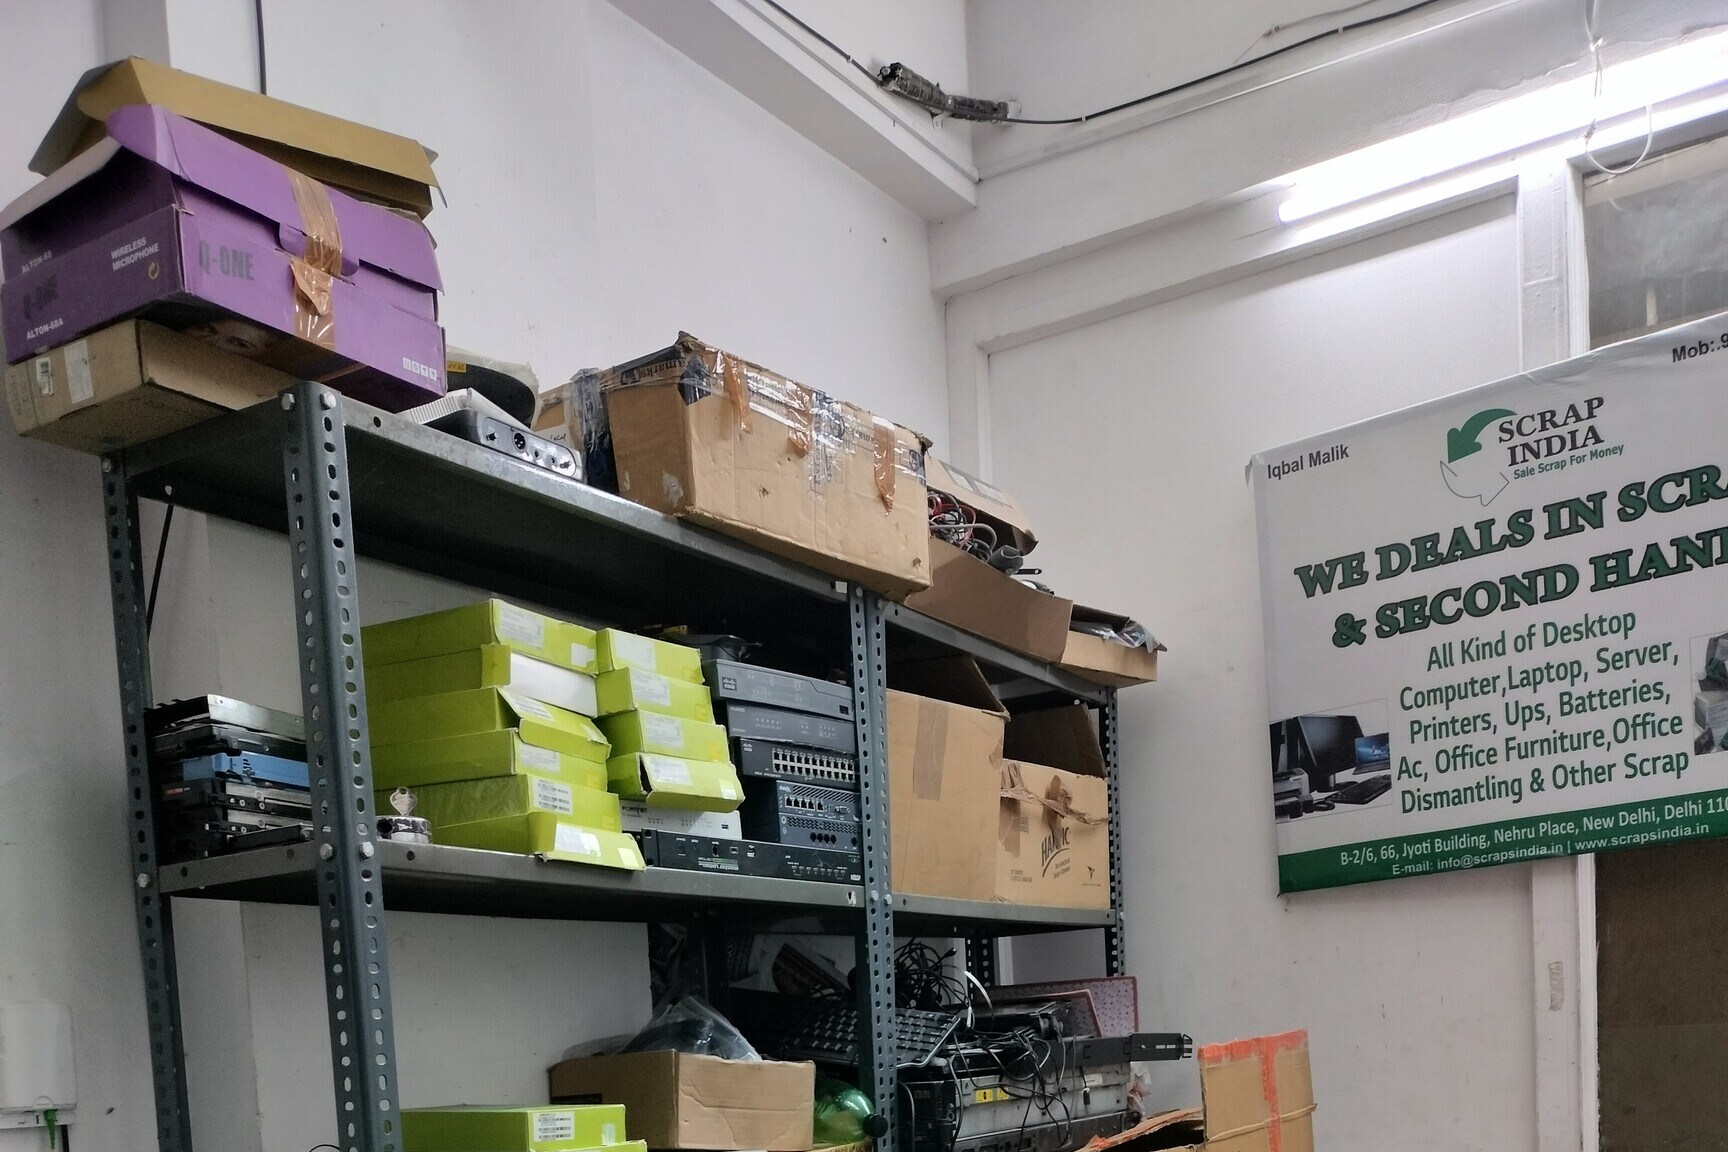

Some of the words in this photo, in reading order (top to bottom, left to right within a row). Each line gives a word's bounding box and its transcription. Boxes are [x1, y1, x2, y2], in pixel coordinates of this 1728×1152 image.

[111, 237, 147, 259] WIRELESS
[112, 243, 160, 271] MICROPHONE
[1498, 396, 1604, 443] SCRAP
[1267, 456, 1304, 480] Iqbal
[1309, 444, 1350, 468] Malik
[1507, 424, 1604, 467] INDIA
[1514, 467, 1536, 480] Sale
[1538, 460, 1567, 474] Scrap
[1570, 454, 1587, 467] For
[1590, 444, 1624, 460] Money
[1293, 551, 1369, 598] WE
[1375, 509, 1535, 580] DEALS
[1543, 491, 1607, 540] IN
[1617, 464, 1728, 523] SCR
[1332, 613, 1367, 648] &
[1375, 562, 1580, 638] SECOND
[1427, 642, 1454, 671] All
[1461, 630, 1507, 662] Kind
[1513, 624, 1536, 653] of
[1543, 611, 1636, 648] Desktop
[1596, 641, 1679, 674] Server,
[1409, 711, 1497, 744] Printers,
[1504, 700, 1551, 731] Ups,
[1559, 679, 1671, 717] Batteries,
[1397, 756, 1428, 782] Ac,
[1435, 744, 1498, 775] Office
[1401, 775, 1523, 814] Dismantling
[1530, 767, 1546, 793] &
[1552, 760, 1617, 790] Other
[1624, 750, 1690, 780] Scrap
[1340, 848, 1378, 866] B-2/6,
[1380, 845, 1399, 860] 66,
[1402, 840, 1431, 859] Jyoti
[1435, 833, 1491, 853] Building,
[1494, 826, 1535, 843] Nehru
[1539, 820, 1579, 836] Place,
[1583, 816, 1615, 831] New
[1618, 807, 1660, 826] Delhi,
[1664, 799, 1702, 820] Delhi
[1392, 860, 1434, 875] E-mail:
[1437, 843, 1563, 870] info@scrapsindia.in
[1575, 824, 1709, 851] www.scrapsindia.in
